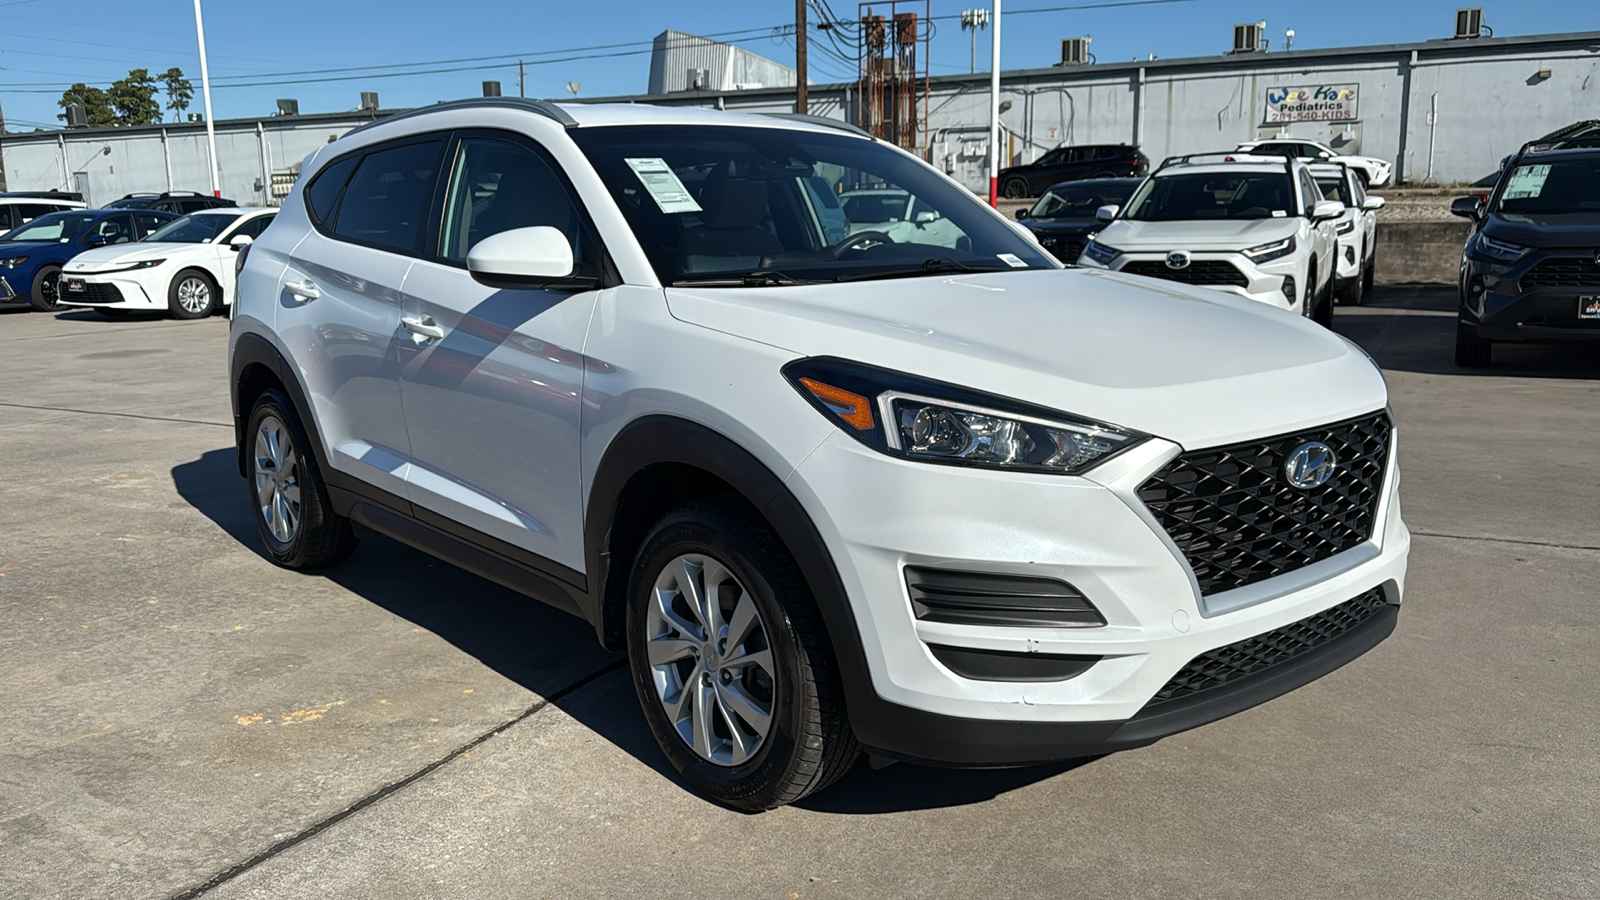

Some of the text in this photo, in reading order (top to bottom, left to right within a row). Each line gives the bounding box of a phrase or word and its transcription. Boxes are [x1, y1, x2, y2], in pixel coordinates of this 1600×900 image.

[1269, 86, 1355, 104] Wee Kare
[1280, 101, 1343, 112] Pediatrics
[1271, 110, 1351, 122] 281-540-KIDS
